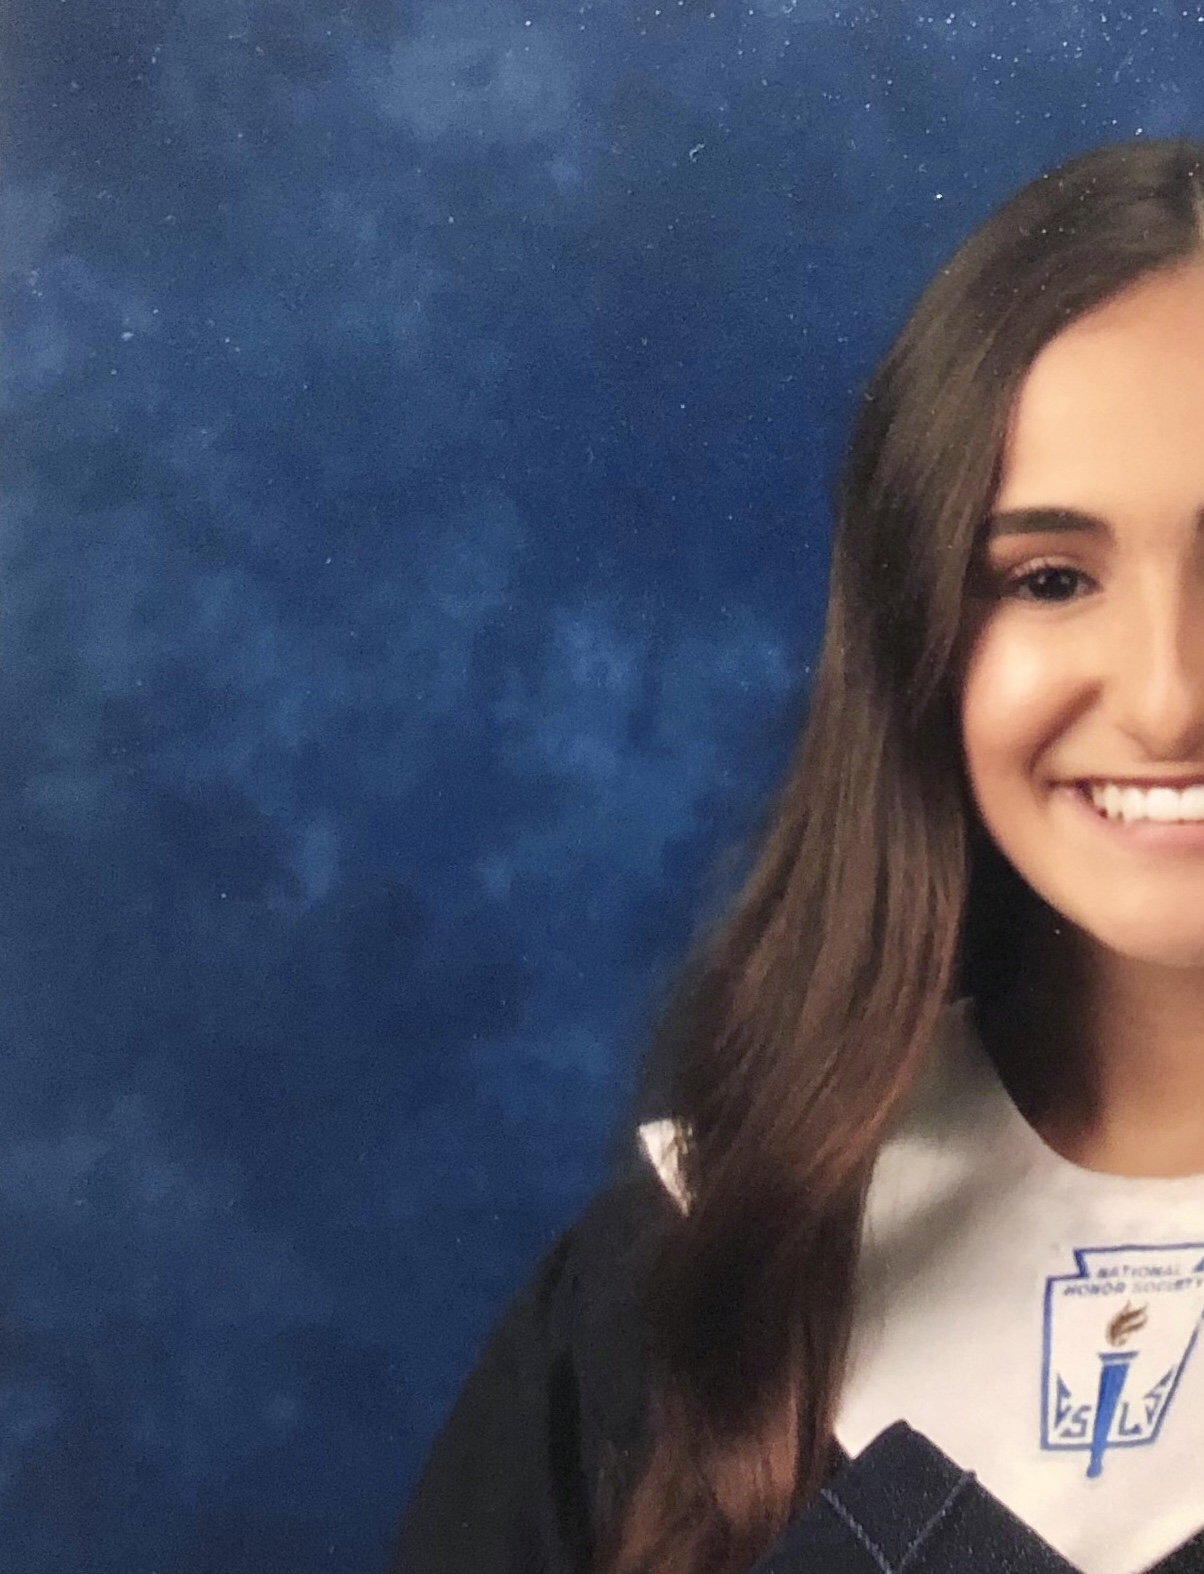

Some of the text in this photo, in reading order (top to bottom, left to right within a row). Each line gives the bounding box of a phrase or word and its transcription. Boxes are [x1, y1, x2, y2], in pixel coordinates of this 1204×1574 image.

[1097, 1264, 1181, 1279] NATIONAL
[1063, 1276, 1204, 1297] HONOR SOCIETY
